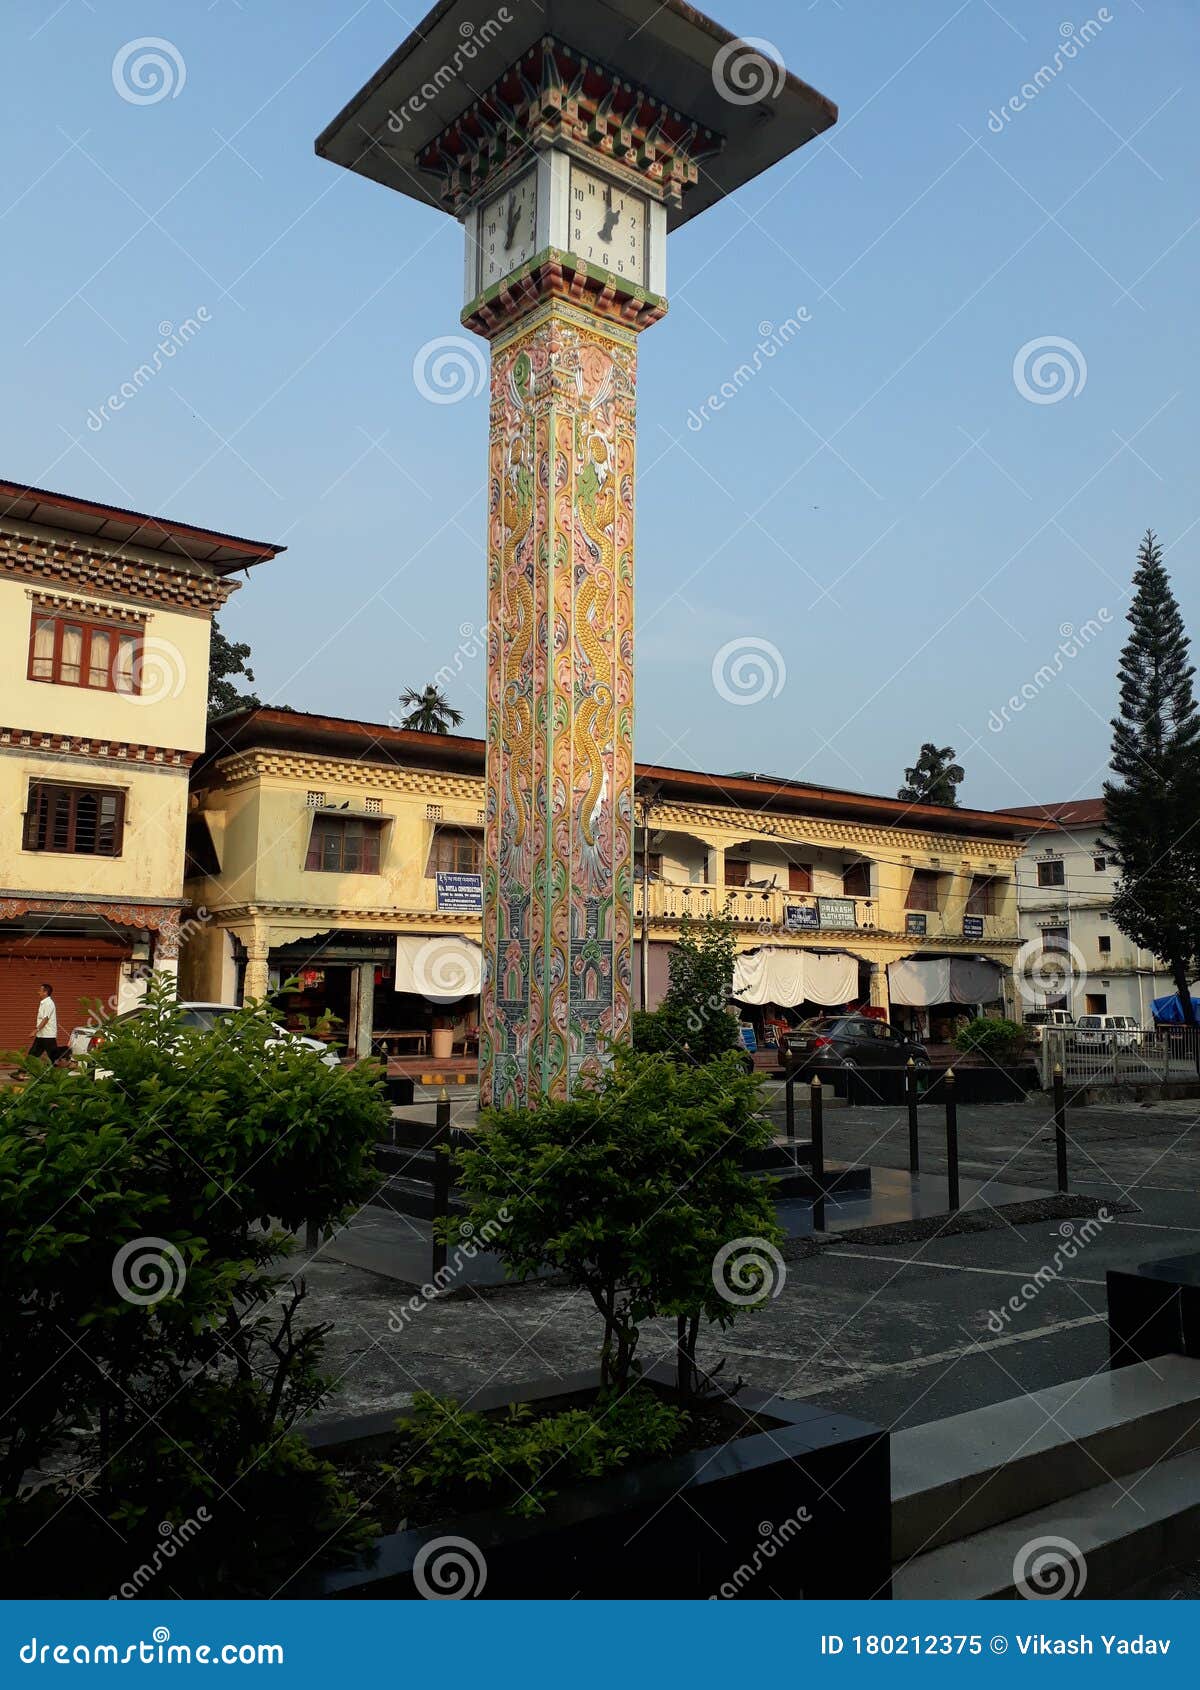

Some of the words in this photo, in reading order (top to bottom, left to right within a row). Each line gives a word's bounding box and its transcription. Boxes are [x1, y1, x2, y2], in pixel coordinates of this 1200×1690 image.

[574, 187, 584, 202] 10
[575, 208, 581, 220] 9
[630, 217, 636, 229] 2
[575, 228, 581, 240] 8
[630, 236, 636, 247] 3
[588, 246, 593, 258] 7
[602, 253, 608, 265] 6
[630, 255, 636, 266] 4
[618, 260, 624, 272] 5
[821, 904, 853, 914] PRAKASH
